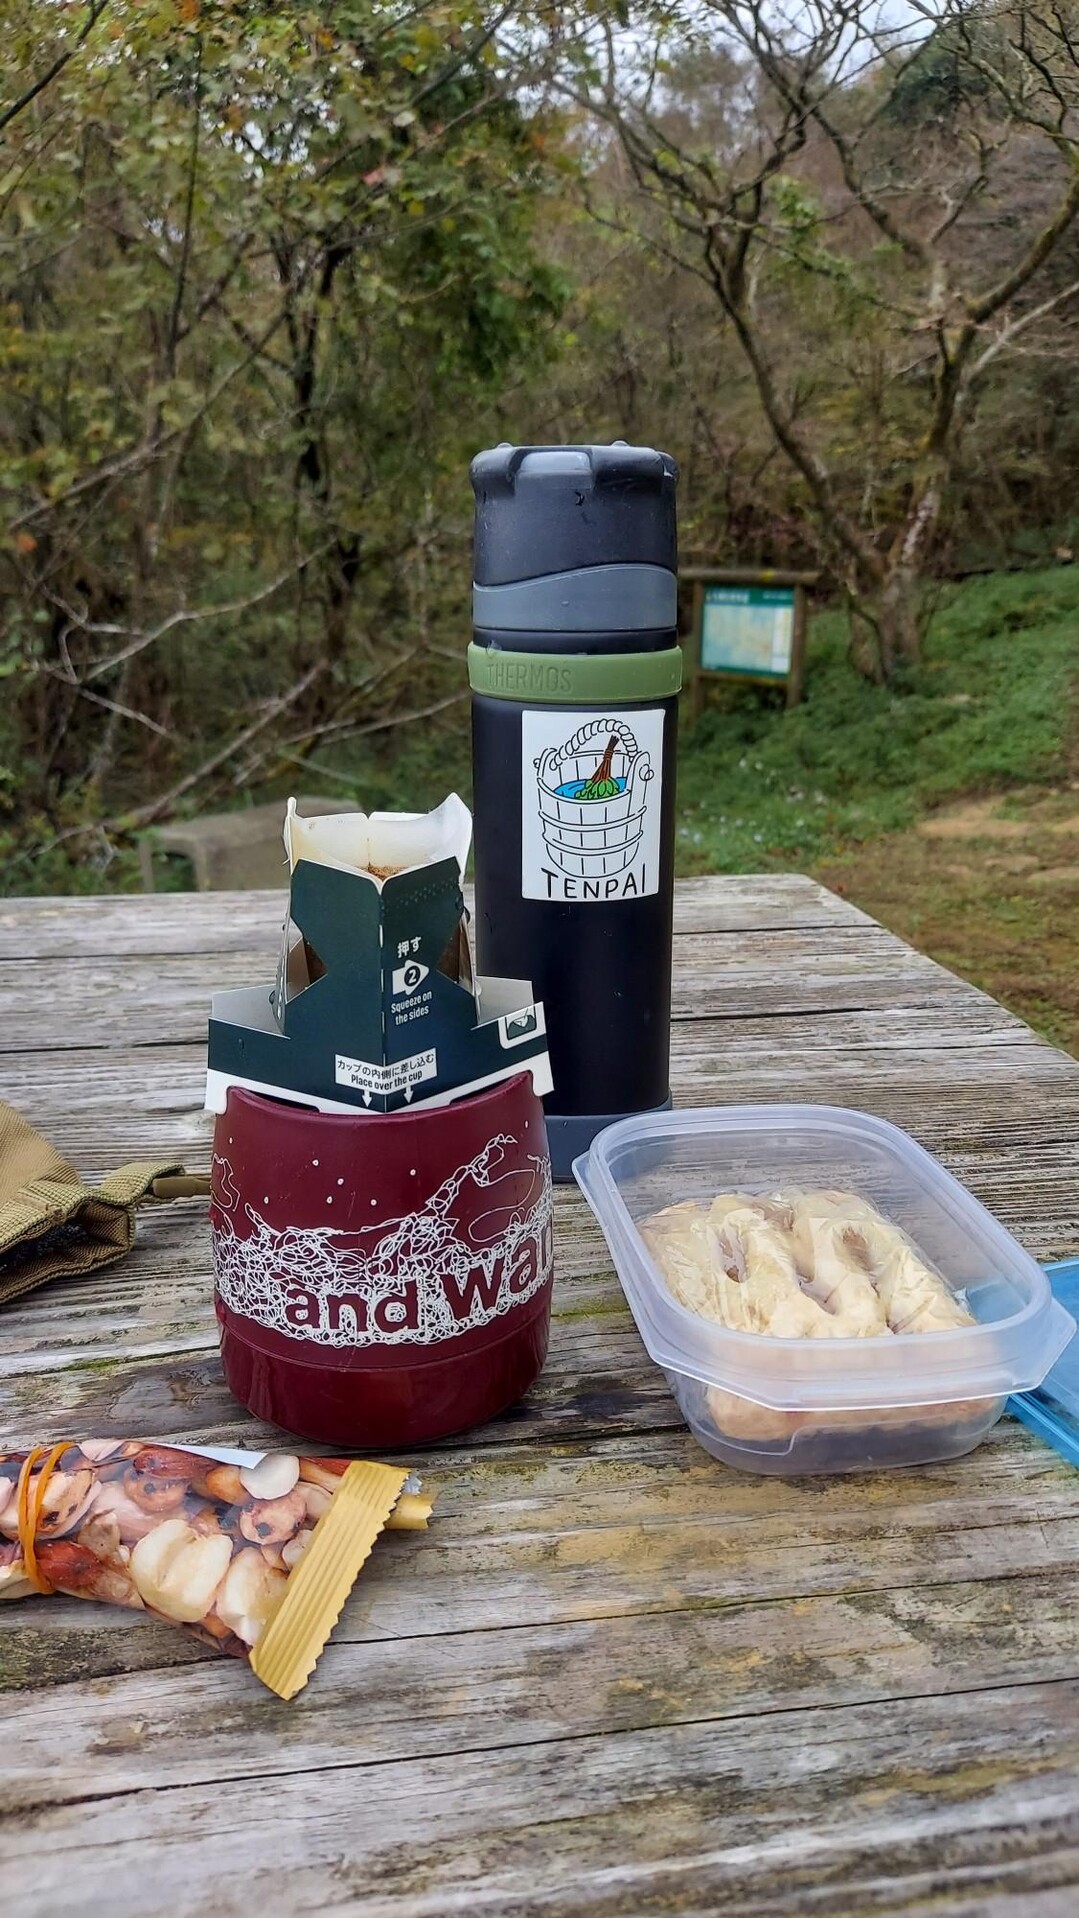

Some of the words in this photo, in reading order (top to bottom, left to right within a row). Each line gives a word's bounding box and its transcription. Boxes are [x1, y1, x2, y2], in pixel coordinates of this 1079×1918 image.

[487, 662, 572, 693] THERMOS
[541, 863, 645, 898] TENPAI
[397, 936, 422, 958] 押す
[408, 968, 418, 984] 2
[391, 995, 422, 1013] Squeeze
[422, 991, 432, 1002] on
[395, 1013, 408, 1026] the
[408, 1005, 430, 1020] sides
[337, 1053, 434, 1080] カップの内側に差し込む
[351, 1074, 373, 1088] Place
[374, 1081, 393, 1091] over
[394, 1075, 407, 1088] the
[408, 1070, 423, 1082] cup
[284, 1279, 420, 1334] and
